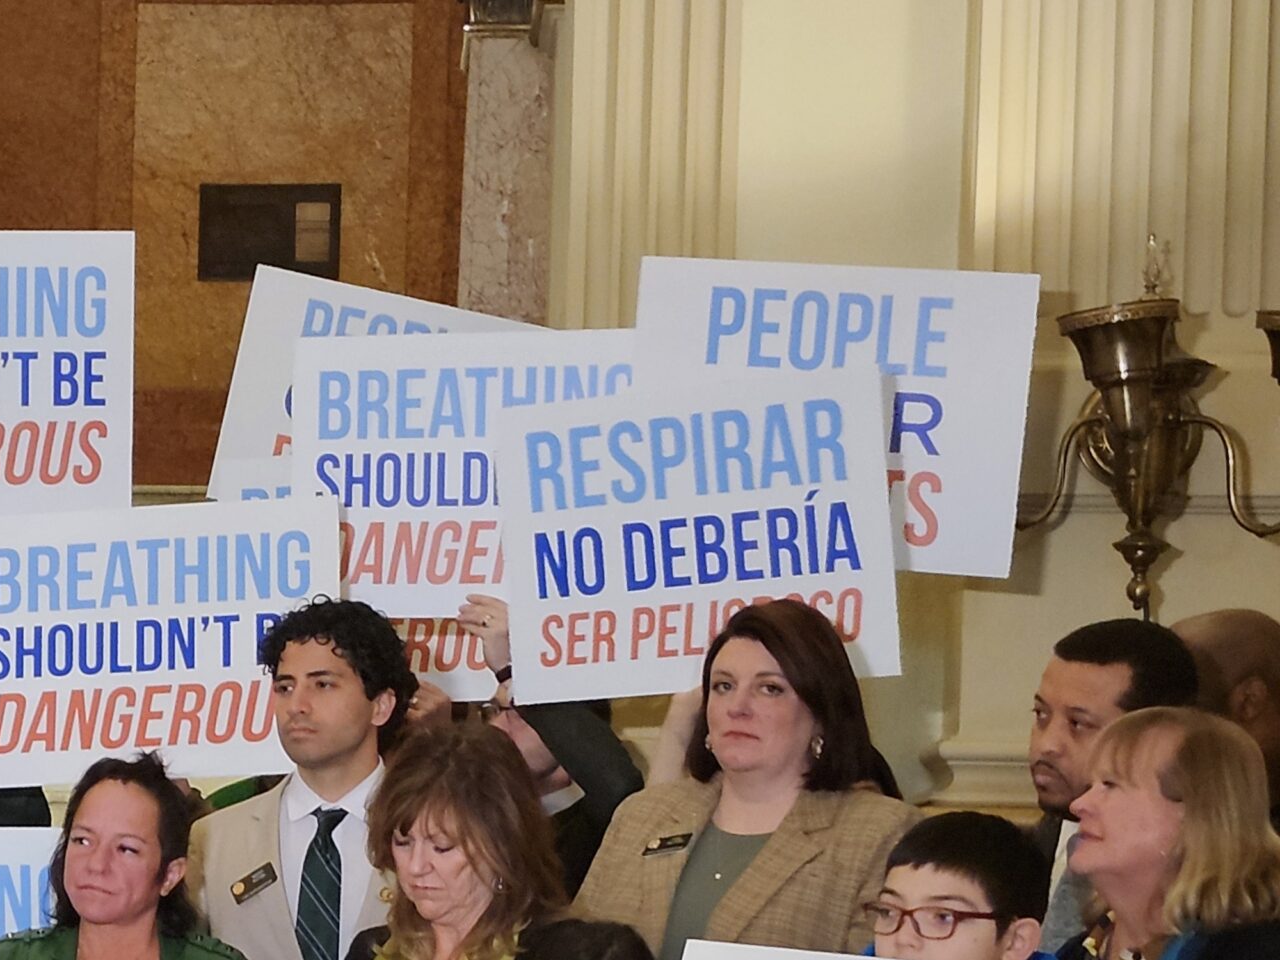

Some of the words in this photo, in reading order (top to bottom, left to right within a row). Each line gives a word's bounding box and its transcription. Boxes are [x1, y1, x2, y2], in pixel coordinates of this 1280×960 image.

[705, 286, 955, 379] PEOPLE
[52, 350, 108, 407] BE
[316, 450, 499, 508] SHOULD
[524, 398, 849, 513] RESPIRAR
[533, 526, 607, 600] NO
[622, 489, 864, 593] DEBERÍA
[539, 608, 617, 668] SER
